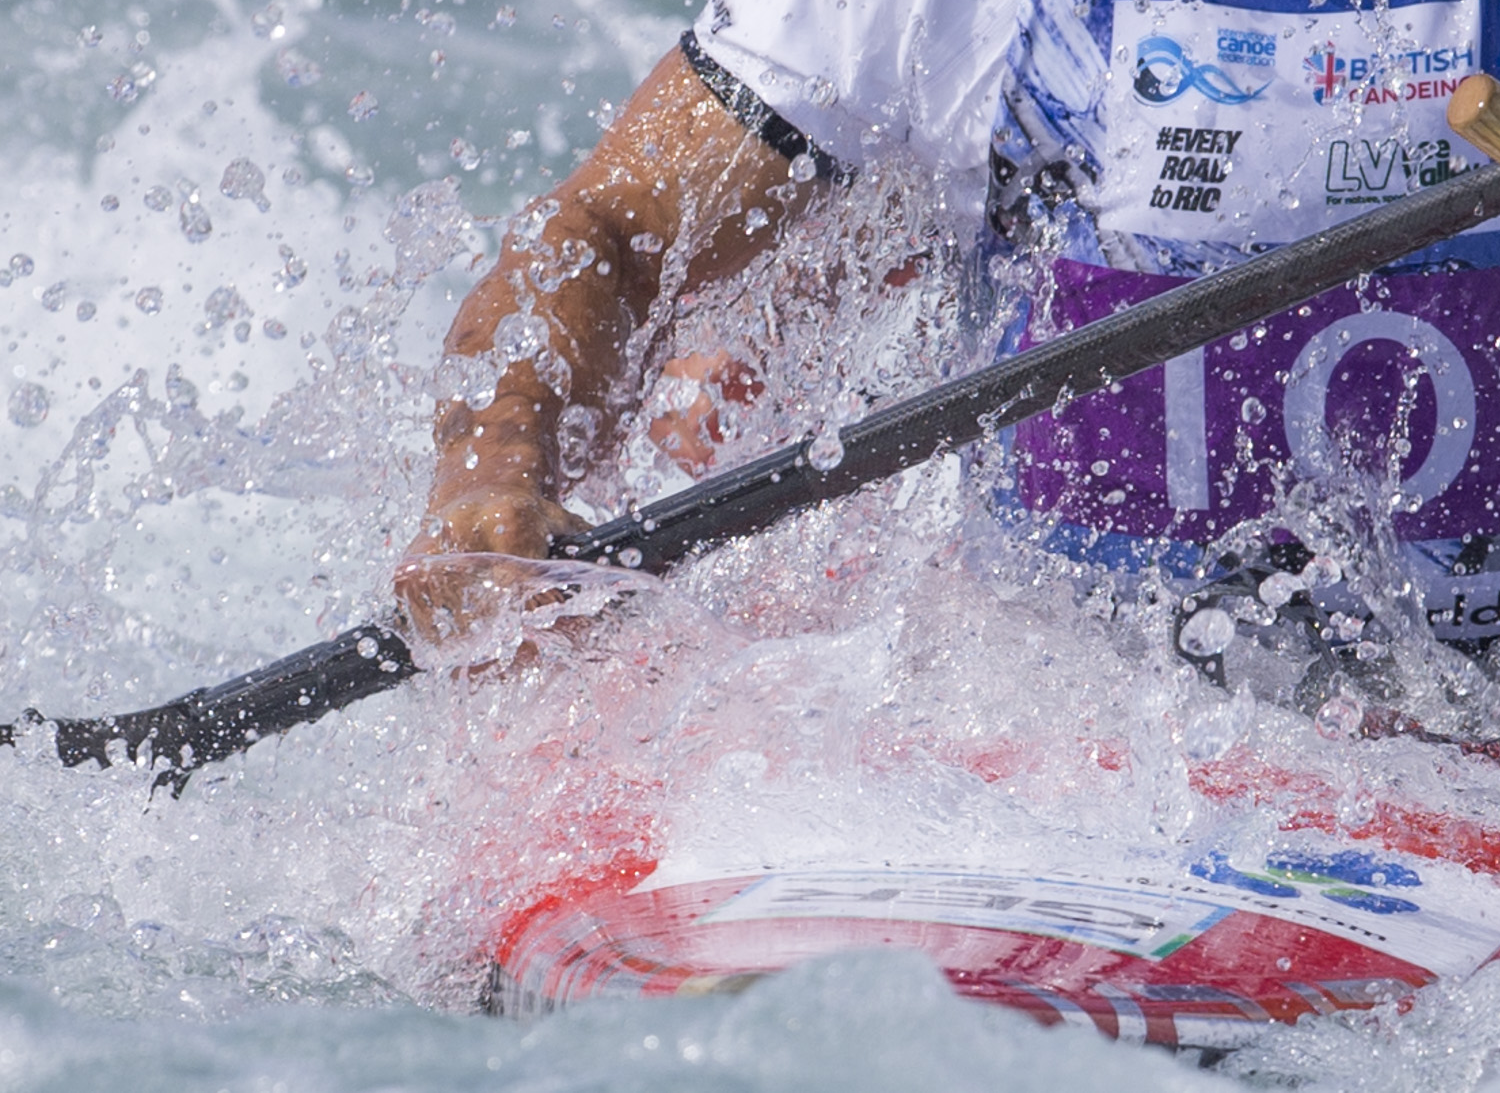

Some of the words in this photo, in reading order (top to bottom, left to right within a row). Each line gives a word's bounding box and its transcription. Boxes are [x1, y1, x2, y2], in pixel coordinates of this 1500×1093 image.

[1217, 36, 1277, 56] canoe
[1351, 47, 1473, 85] BTISH
[1349, 75, 1471, 105] CANOEIN
[1156, 127, 1243, 154] #EVERY
[1159, 156, 1229, 183] ROAD
[1326, 139, 1401, 192] LV
[1402, 160, 1480, 187] Vall
[1149, 185, 1173, 208] to
